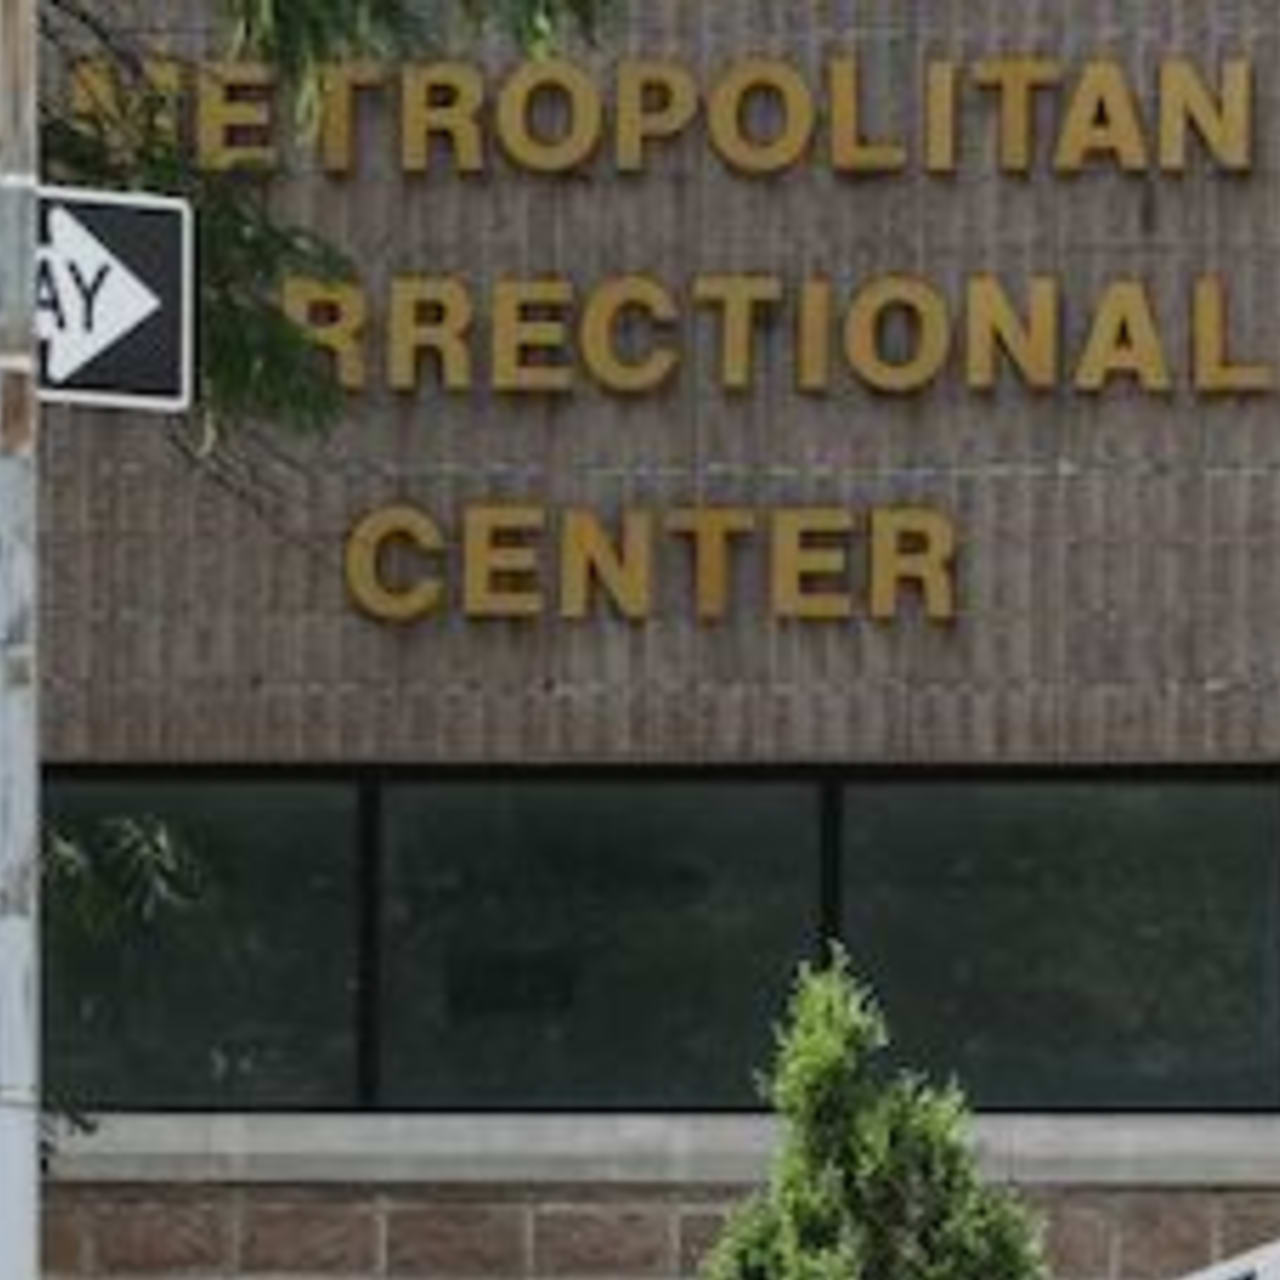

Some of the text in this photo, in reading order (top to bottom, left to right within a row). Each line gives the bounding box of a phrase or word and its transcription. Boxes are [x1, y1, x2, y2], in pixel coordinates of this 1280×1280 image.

[36, 258, 111, 332] AY
[282, 273, 1276, 394] RRECTIONAL
[344, 505, 960, 619] CENTER
